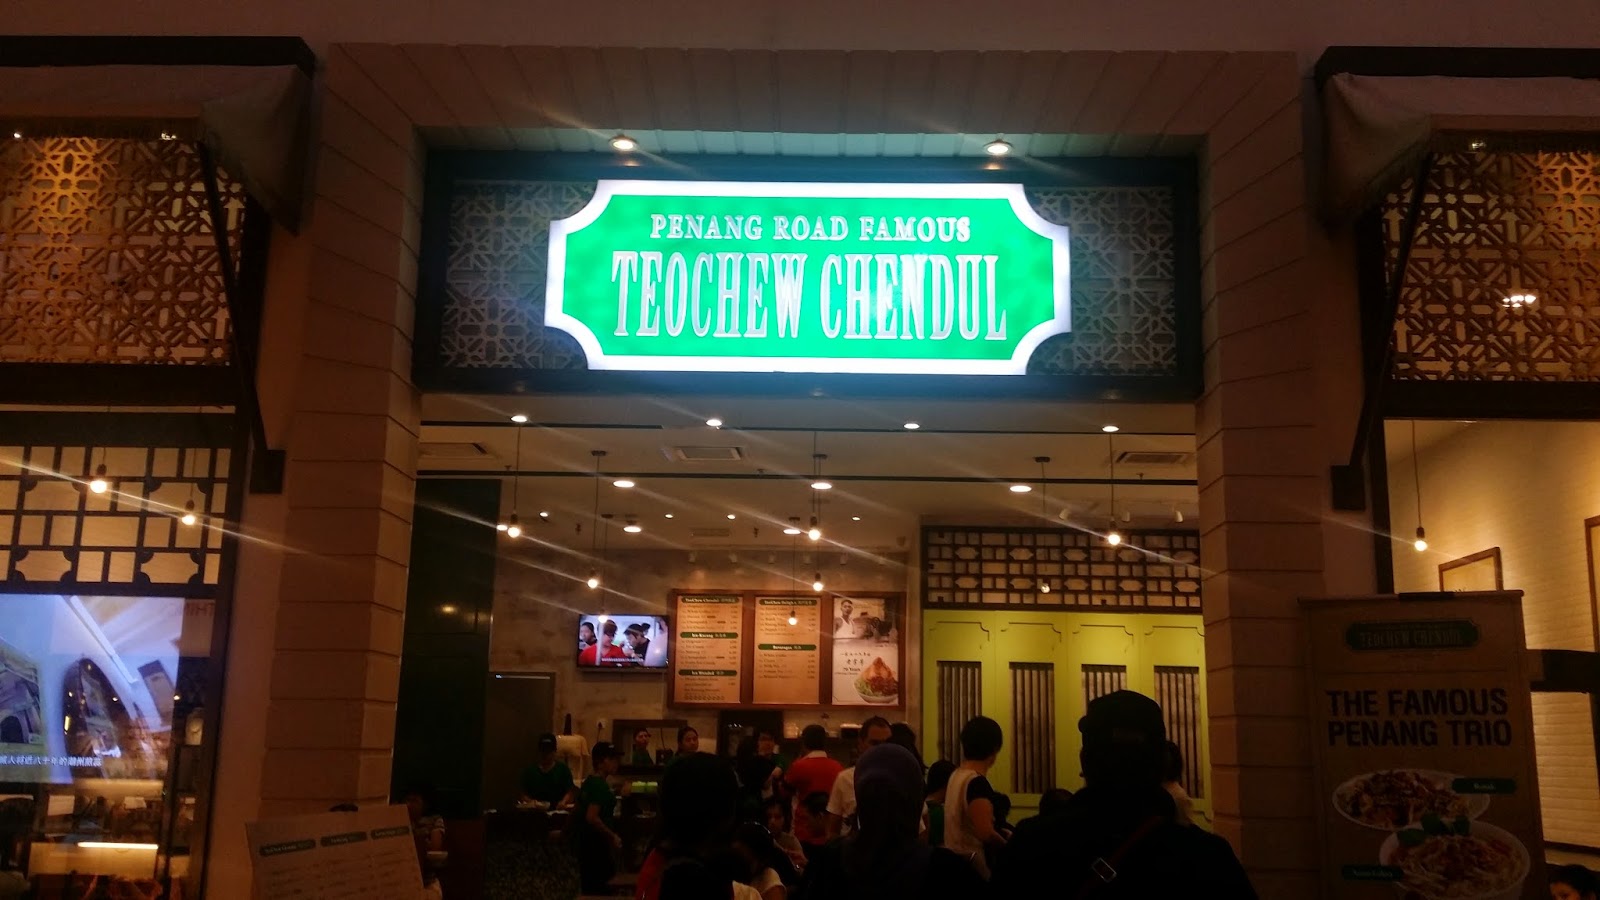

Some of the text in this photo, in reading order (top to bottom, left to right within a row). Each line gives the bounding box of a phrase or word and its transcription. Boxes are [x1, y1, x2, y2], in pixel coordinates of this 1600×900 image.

[650, 213, 971, 243] PENANG ROAD FAMOUS
[611, 250, 1007, 342] TEOCHEW CHENDUL
[1326, 688, 1508, 717] THE FAMOUS
[1328, 720, 1513, 747] PENANG TRIO
